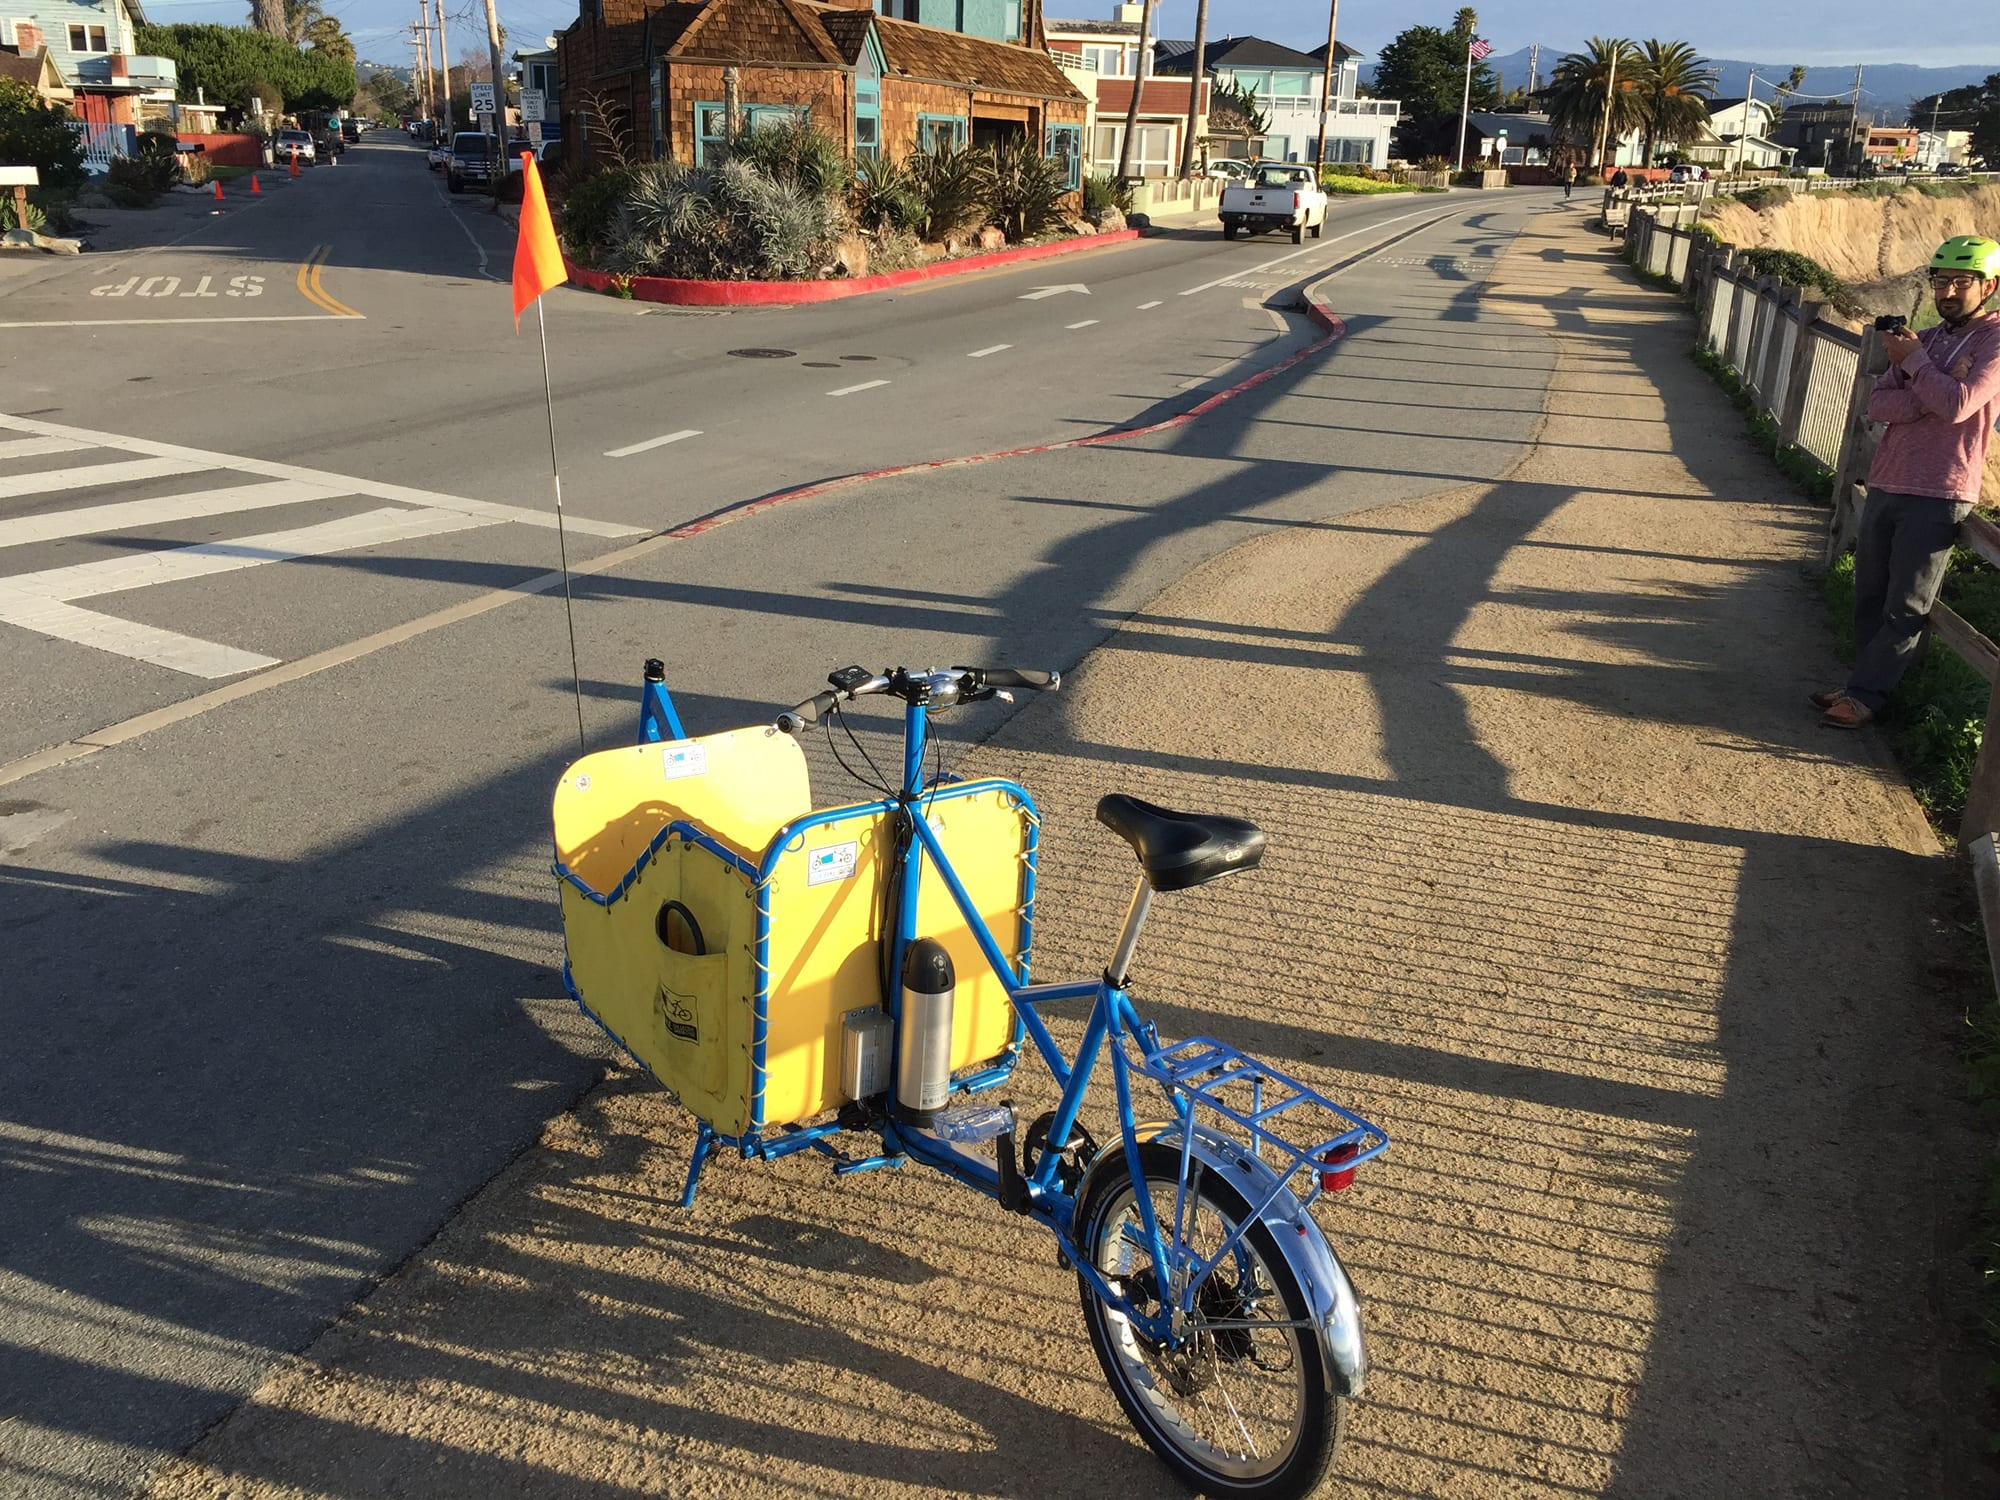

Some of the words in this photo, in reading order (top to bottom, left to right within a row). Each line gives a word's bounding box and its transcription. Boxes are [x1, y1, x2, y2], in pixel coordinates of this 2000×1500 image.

[474, 100, 494, 111] 25
[90, 275, 266, 297] STOP
[1218, 280, 1276, 290] BIKE
